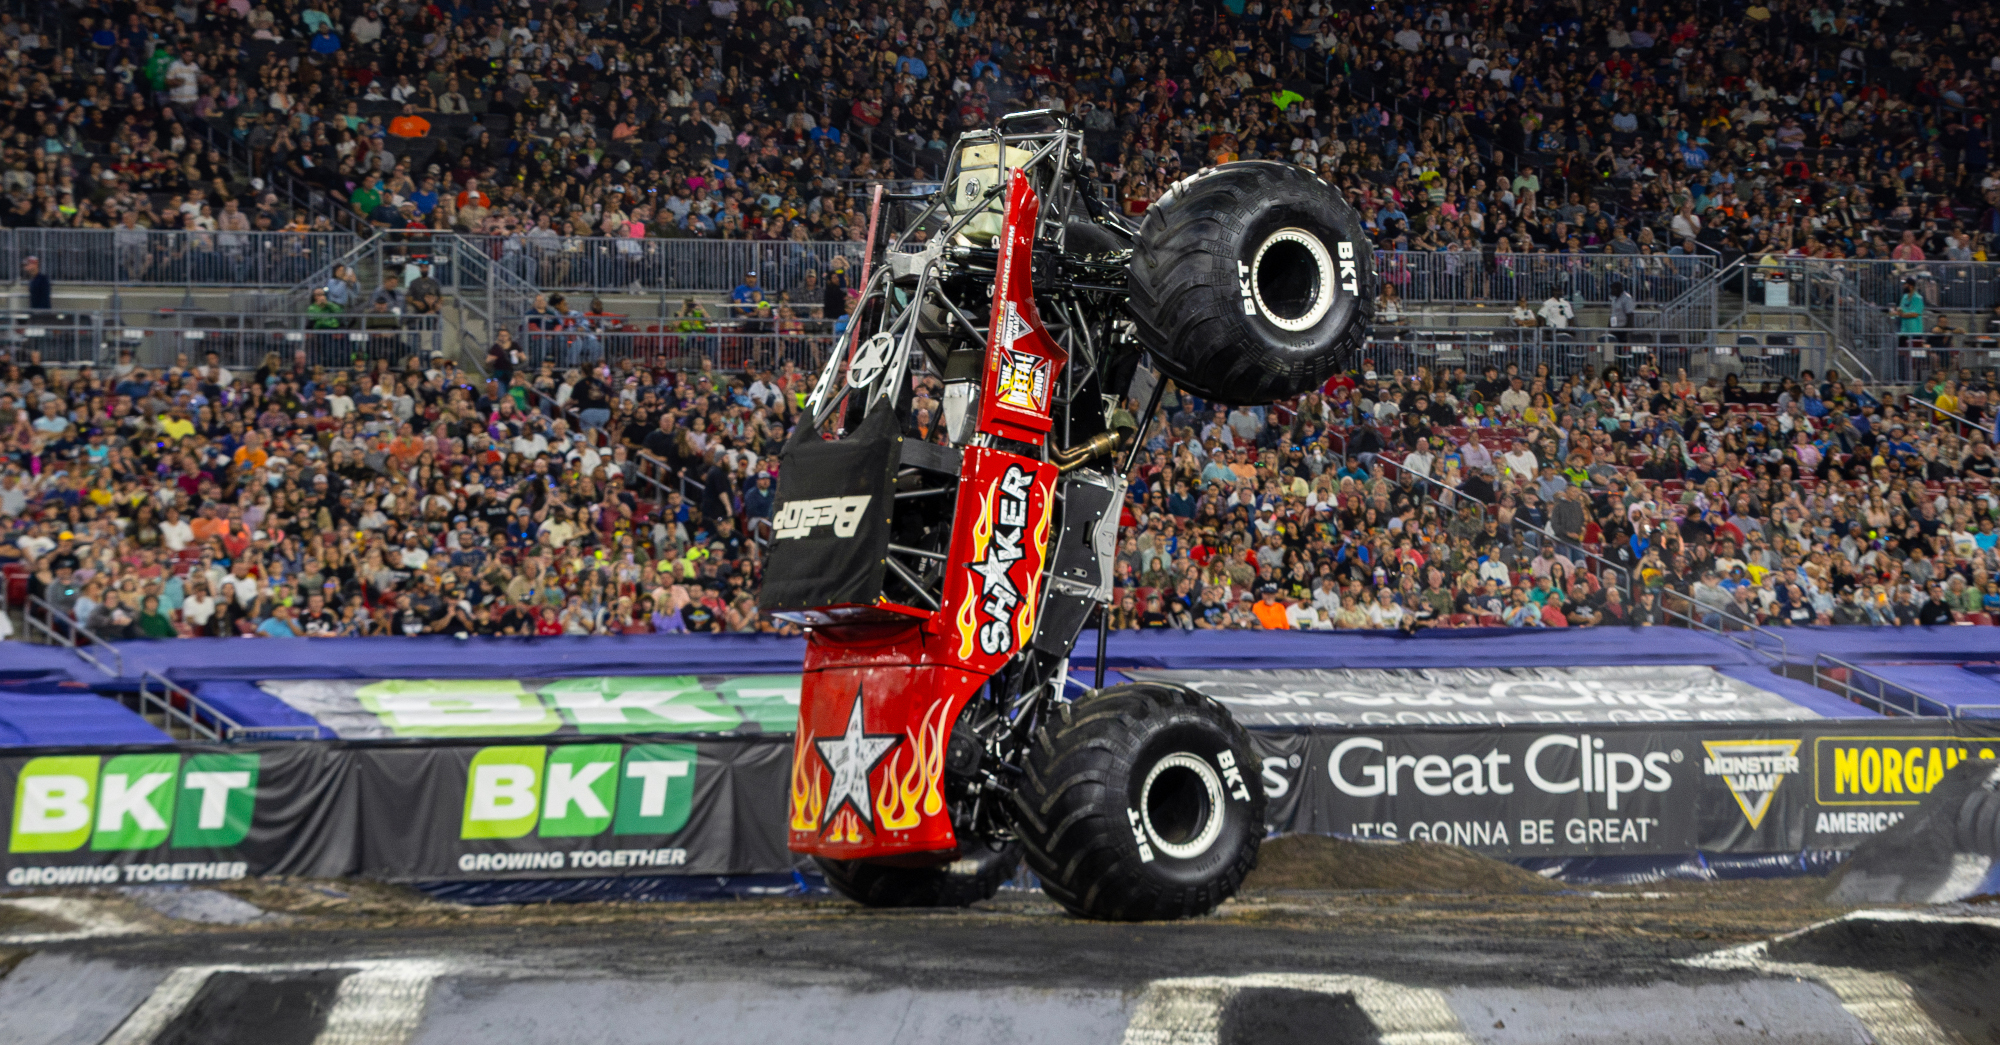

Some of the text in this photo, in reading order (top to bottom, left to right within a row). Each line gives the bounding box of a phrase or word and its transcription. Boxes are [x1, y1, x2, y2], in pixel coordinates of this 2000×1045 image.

[1237, 259, 1257, 316] BKT
[1336, 241, 1359, 297] BKT
[1004, 300, 1018, 350] MONSTER
[1012, 316, 1021, 339] JAM
[1000, 364, 1013, 386] THE
[1008, 354, 1035, 406] METAL
[1032, 369, 1045, 397] SHOP
[469, 760, 690, 820] BKT
[1217, 749, 1251, 802] BKT
[1328, 736, 1514, 798] Great
[1704, 756, 1799, 775] MONSTER
[1731, 774, 1774, 792] JAM
[18, 771, 251, 834] BKT
[1126, 807, 1155, 864] BKT
[1409, 820, 1509, 846] GONNA
[1520, 819, 1555, 845] BE
[1565, 818, 1651, 845] GREAT
[7, 861, 249, 886] GROWING TOGETHER
[458, 848, 688, 872] GROWING TOGETHER
